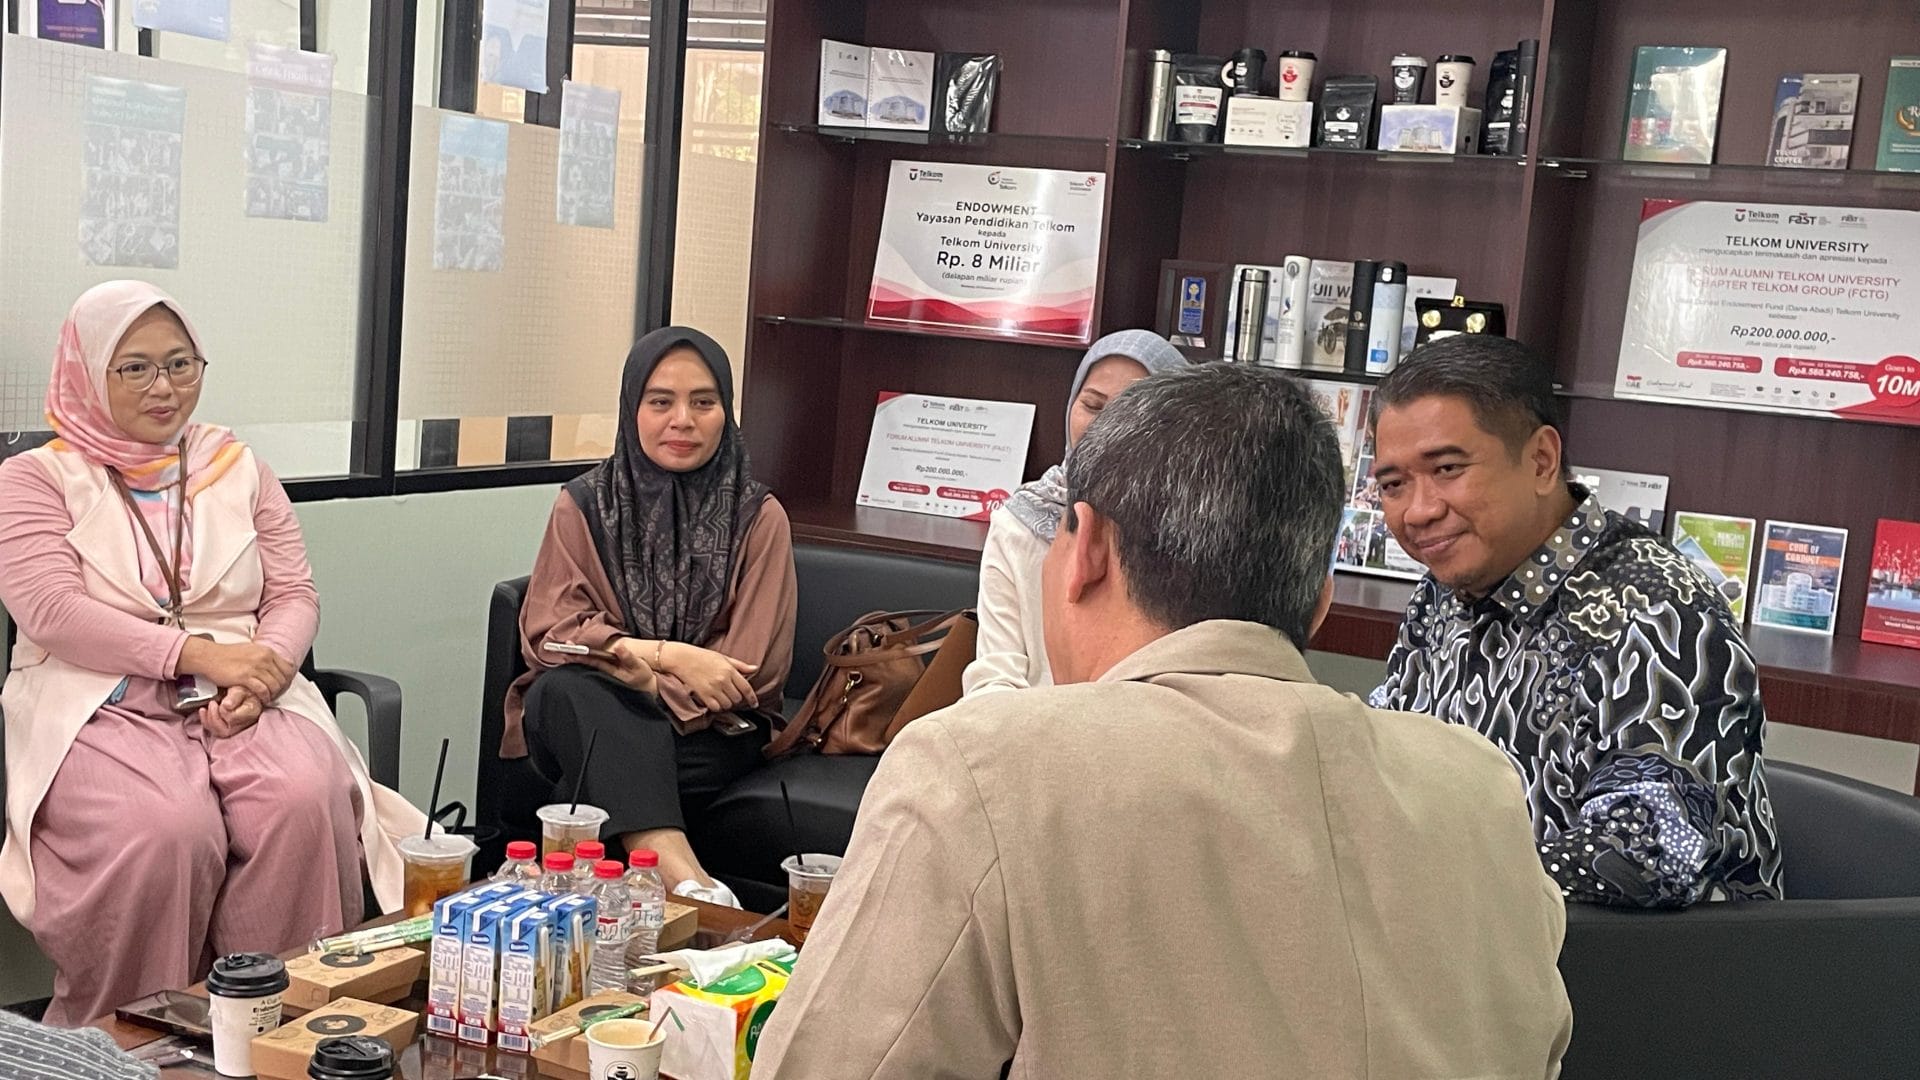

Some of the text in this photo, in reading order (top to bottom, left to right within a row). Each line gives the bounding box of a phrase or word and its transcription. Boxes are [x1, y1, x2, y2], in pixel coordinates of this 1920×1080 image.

[956, 201, 1037, 216] ENDOWMENT
[1748, 211, 1779, 219] Telkom
[916, 212, 1075, 233] Yayasan Pendidikan Telkom
[978, 229, 1007, 238] kepada
[940, 236, 1043, 254] Telkom University
[1726, 236, 1869, 253] TELKOM UNIVERSITY
[1699, 247, 1753, 257] mengucapkan
[1802, 253, 1817, 261] dan
[936, 251, 1040, 274] Rp. 8 Miliar
[1730, 267, 1774, 279] ALUMNI
[1777, 271, 1825, 283] TELKOM
[1828, 274, 1901, 287] UNIVERSITY
[1752, 281, 1798, 293] TELKOM
[1801, 285, 1846, 296] GROUP
[1848, 288, 1889, 301] (FCTG)
[1765, 302, 1784, 311] Fund
[1836, 308, 1861, 316] Telkom
[1863, 310, 1900, 320] University
[1730, 325, 1836, 344] Rp200.000.000,-
[1885, 363, 1915, 373] Goes to
[917, 417, 946, 426] TELKOM
[947, 421, 987, 431] UNIVERSITY
[1788, 543, 1820, 554] CODE OF
[1785, 553, 1820, 565] CONDUCT
